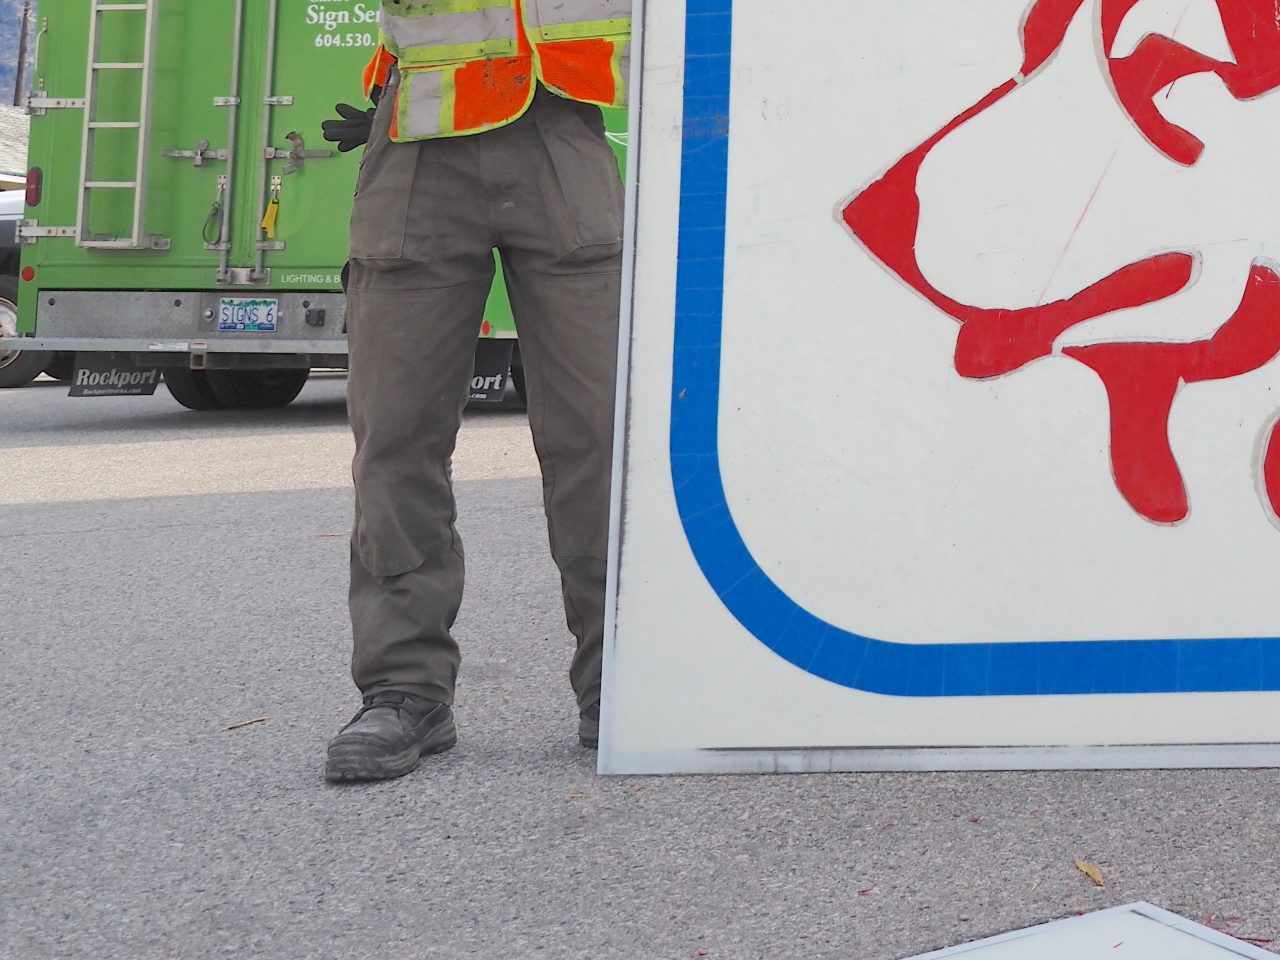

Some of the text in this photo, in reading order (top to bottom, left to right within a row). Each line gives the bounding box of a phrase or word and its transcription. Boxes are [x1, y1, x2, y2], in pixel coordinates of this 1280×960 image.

[306, 4, 350, 30] Sign
[281, 274, 323, 283] LIGHTING
[325, 274, 332, 283] &
[222, 307, 273, 323] SIGNS 6
[76, 368, 157, 388] Rockport
